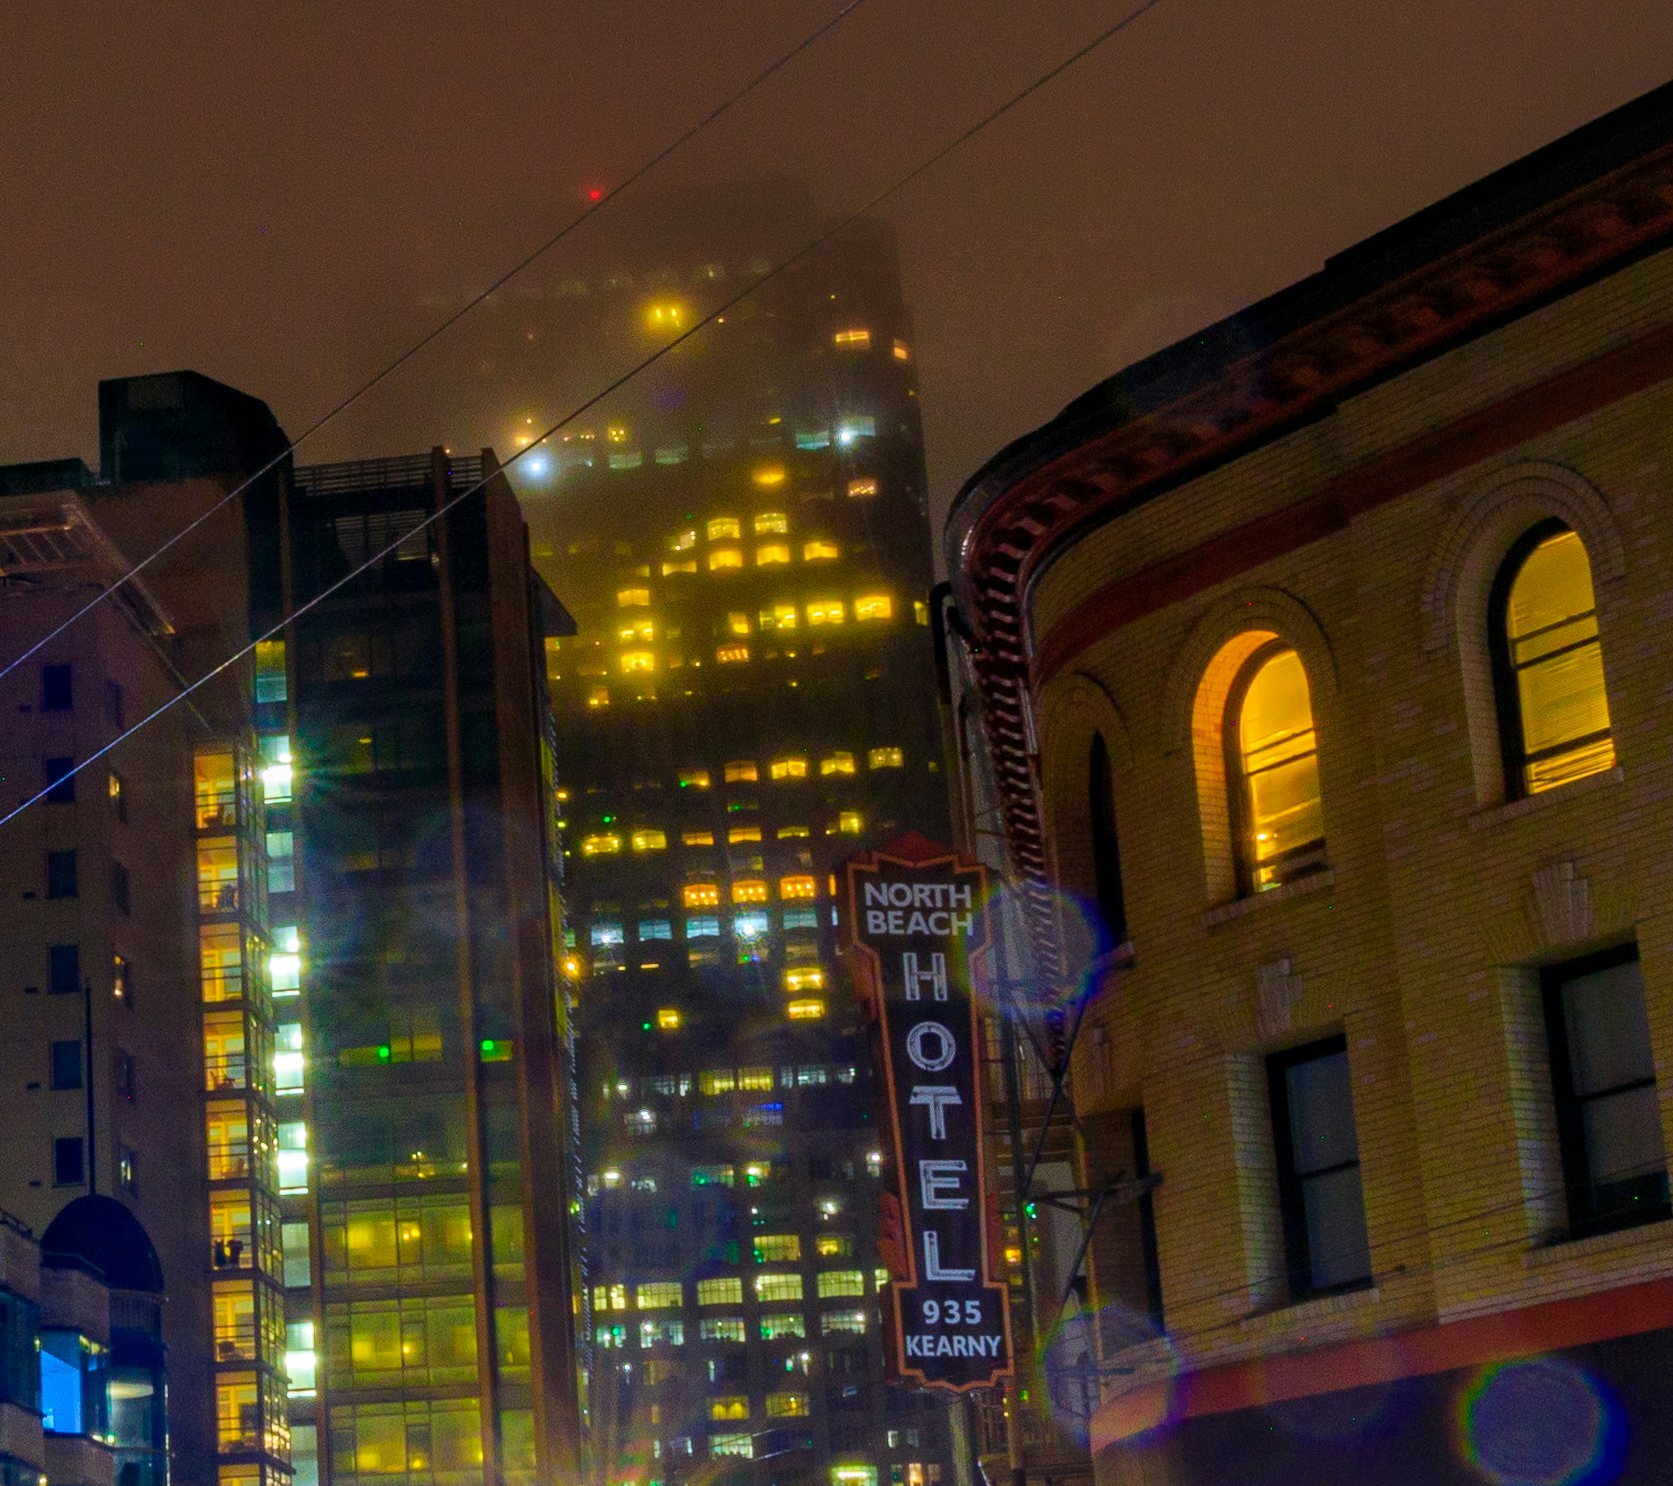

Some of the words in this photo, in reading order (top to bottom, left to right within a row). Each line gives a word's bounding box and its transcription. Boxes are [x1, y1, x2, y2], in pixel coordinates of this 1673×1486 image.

[863, 881, 972, 908] NORTH
[866, 909, 974, 936] BEACH
[902, 951, 976, 1282] HOTEL
[922, 1299, 982, 1324] 935
[905, 1334, 1002, 1357] KEARNY
